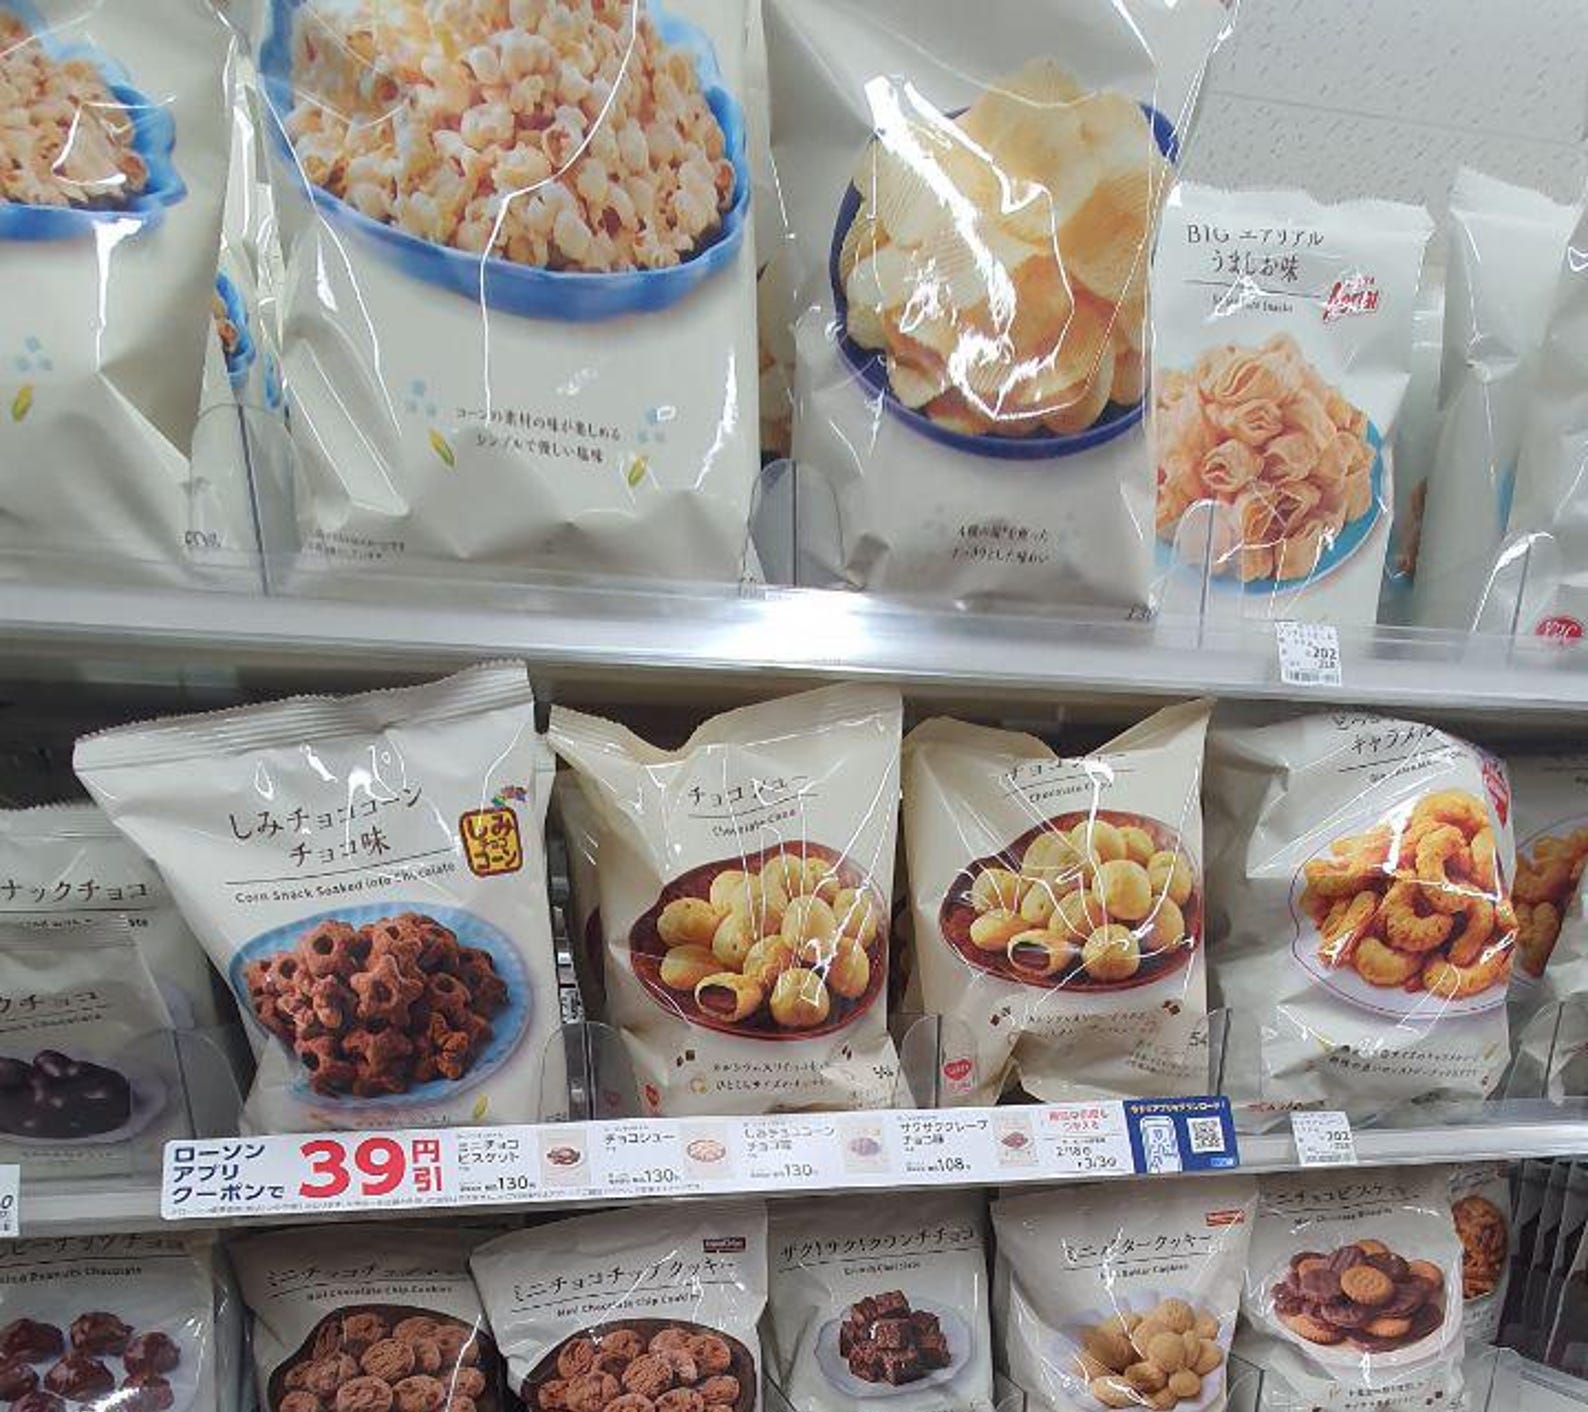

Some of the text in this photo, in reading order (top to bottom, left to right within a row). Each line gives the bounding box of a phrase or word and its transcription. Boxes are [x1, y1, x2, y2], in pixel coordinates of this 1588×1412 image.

[1187, 224, 1325, 247] BIG エアリアル
[1210, 249, 1299, 283] うましお味
[1313, 646, 1337, 661] 202
[229, 787, 422, 841] しみチョココーン
[288, 826, 391, 868] チョコ味
[605, 1134, 676, 1145] チョコシュー
[174, 1144, 266, 1162] ローソン
[173, 1164, 239, 1183] アプリ
[299, 1138, 406, 1198] 39
[172, 1183, 284, 1204] クーポンで
